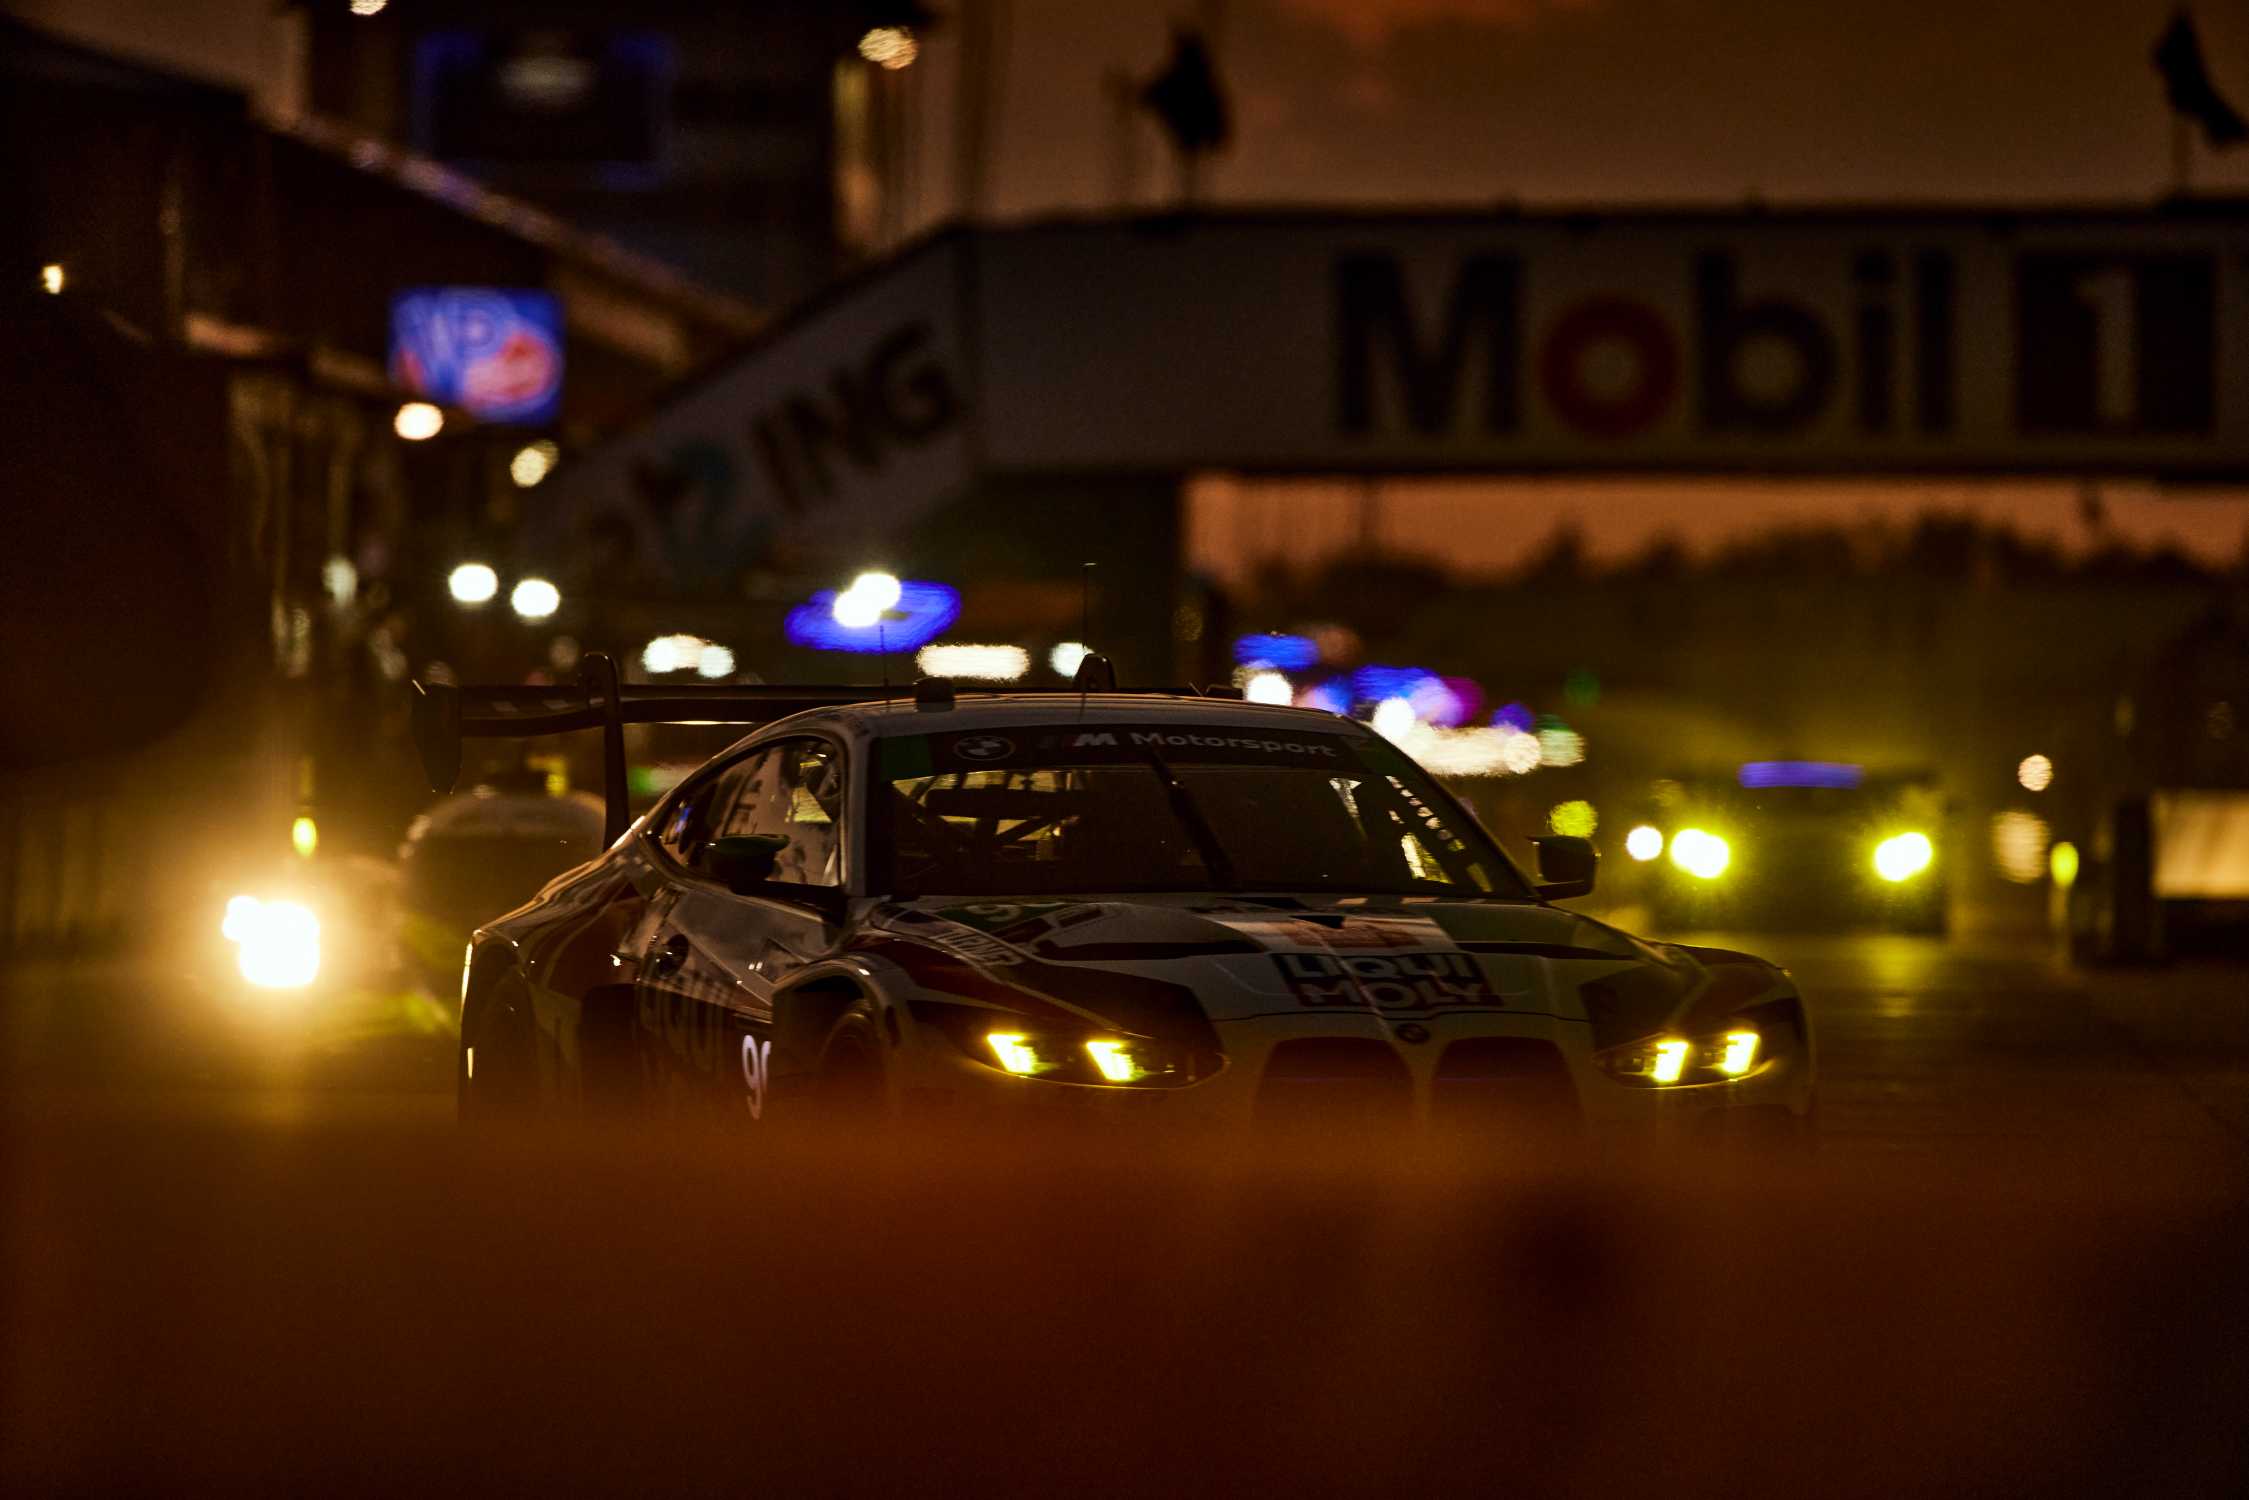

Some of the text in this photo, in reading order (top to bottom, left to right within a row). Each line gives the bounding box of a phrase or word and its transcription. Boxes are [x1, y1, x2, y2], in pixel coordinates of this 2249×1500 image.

[1339, 247, 2137, 438] Mobil 1
[1129, 733, 1337, 759] Motorsport
[1278, 953, 1482, 980] LIQUI
[1300, 977, 1488, 1009] MOLY
